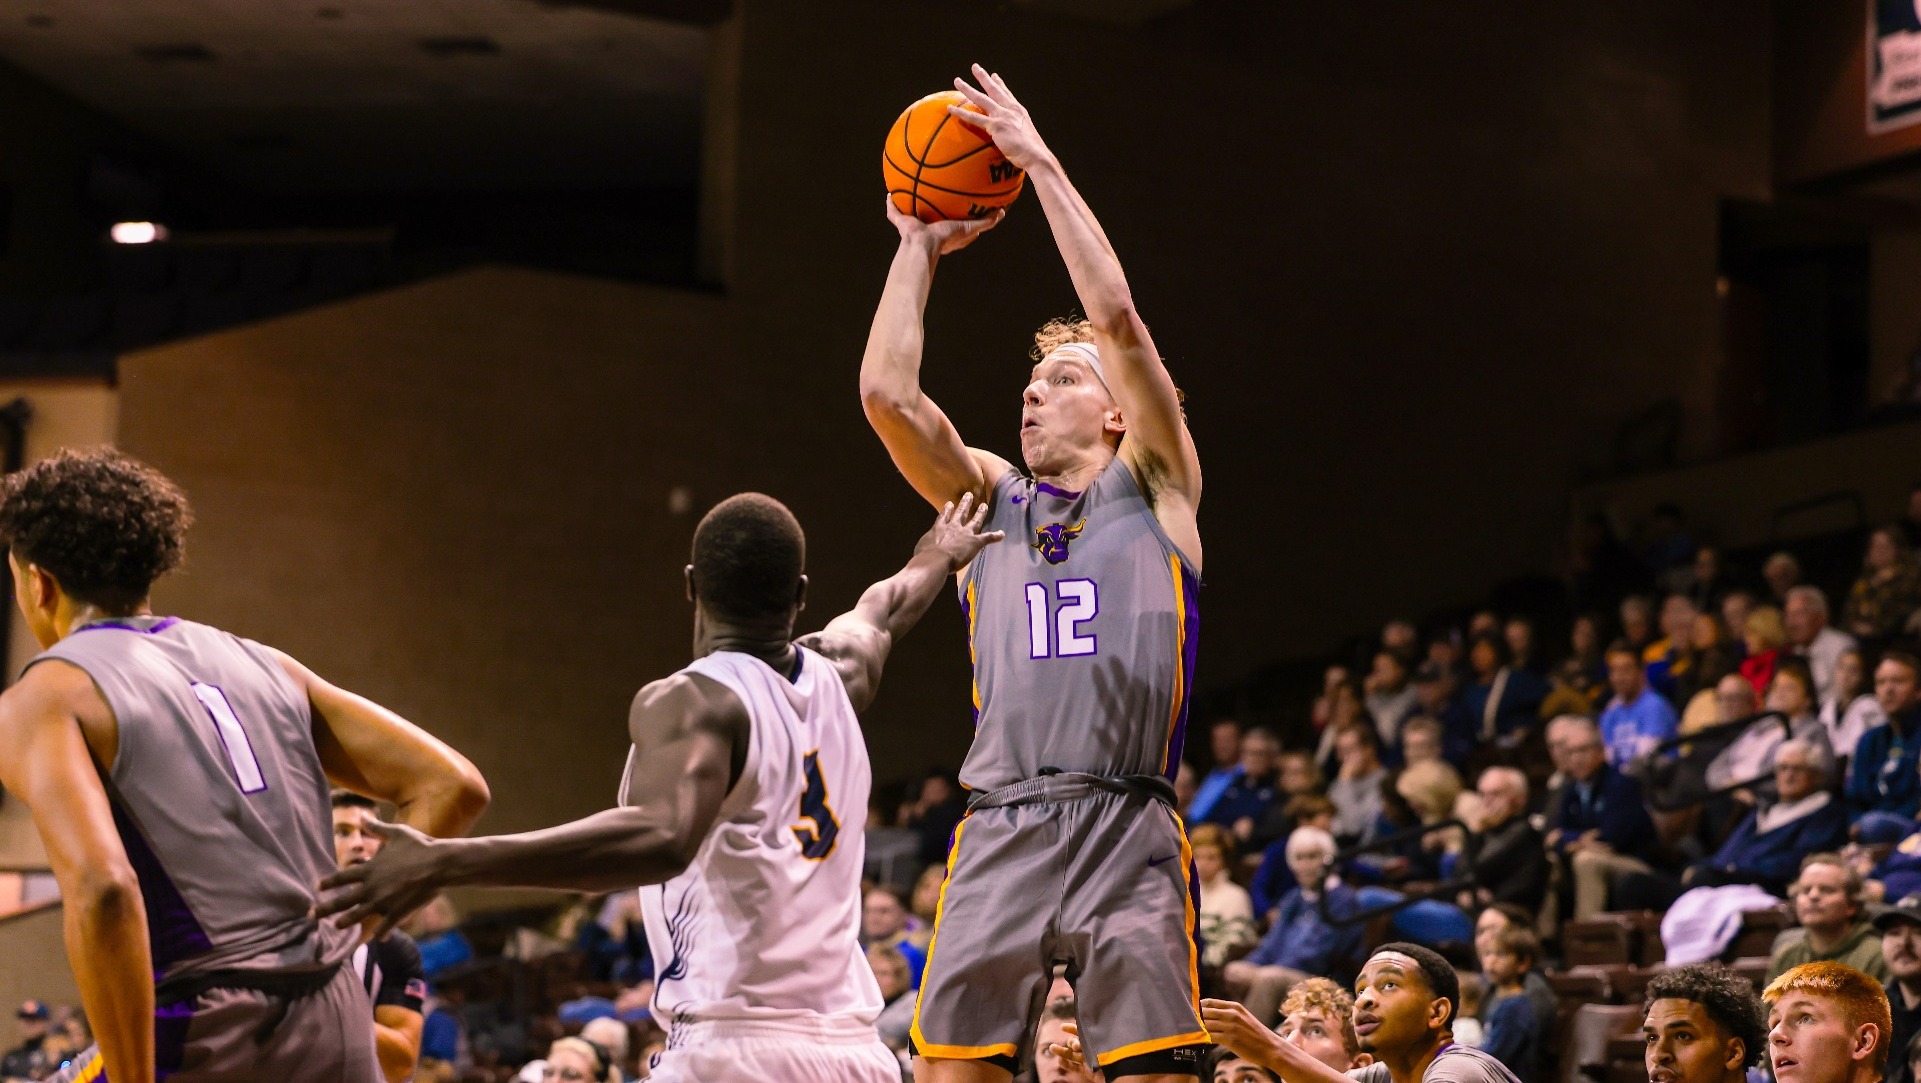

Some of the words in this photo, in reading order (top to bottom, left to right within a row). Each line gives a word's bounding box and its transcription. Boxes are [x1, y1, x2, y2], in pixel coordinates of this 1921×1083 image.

[1025, 578, 1099, 660] 12
[189, 681, 268, 795] 1
[789, 748, 841, 862] 3
